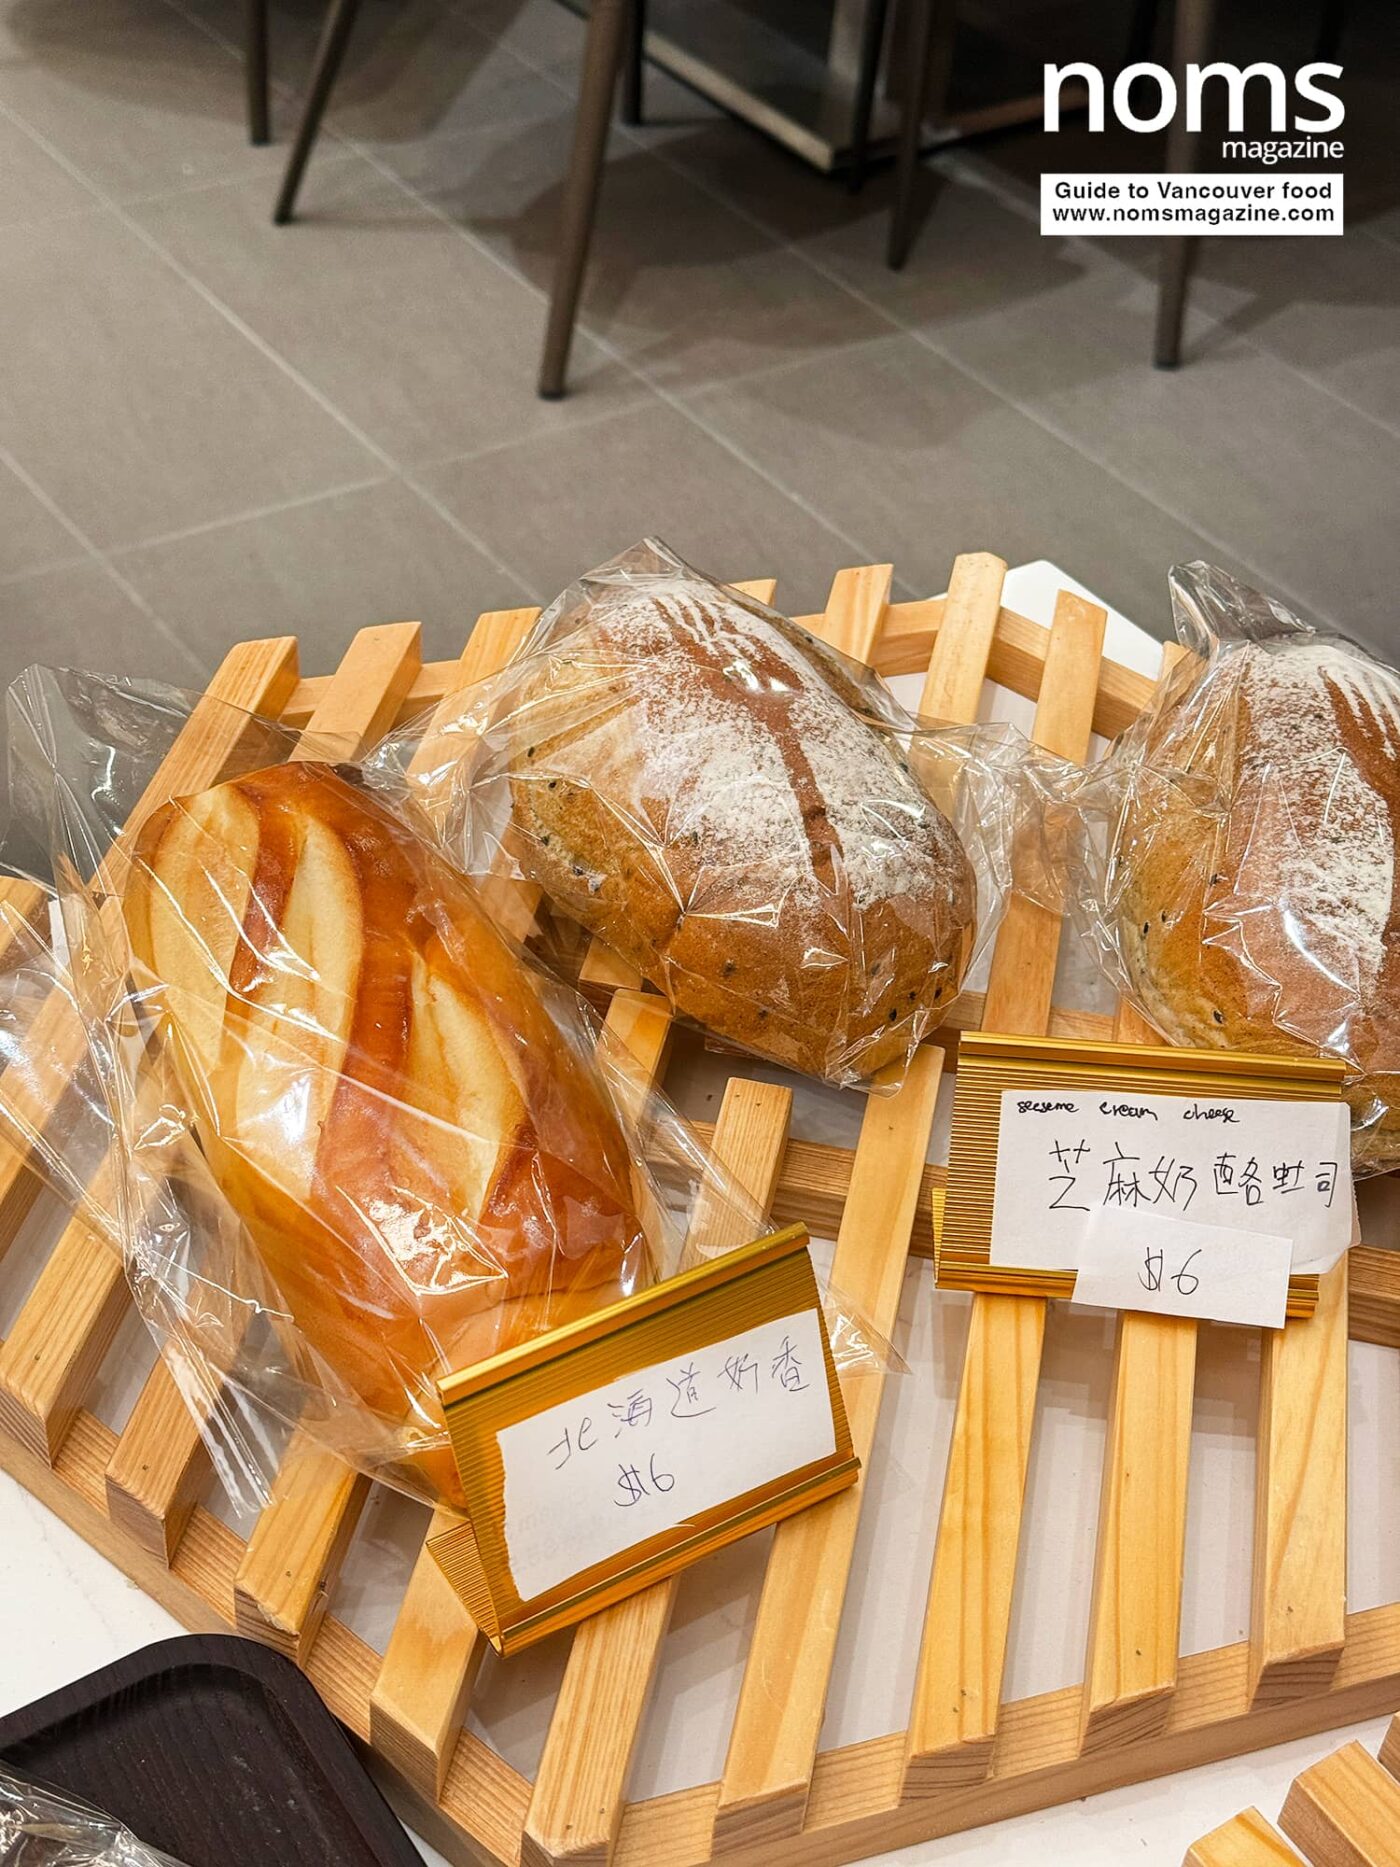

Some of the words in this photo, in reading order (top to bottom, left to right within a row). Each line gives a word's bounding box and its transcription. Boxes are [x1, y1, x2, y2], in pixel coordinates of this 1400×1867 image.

[1099, 1101, 1158, 1121] cream
[1138, 1247, 1203, 1296] $6
[613, 1452, 675, 1507] $6
